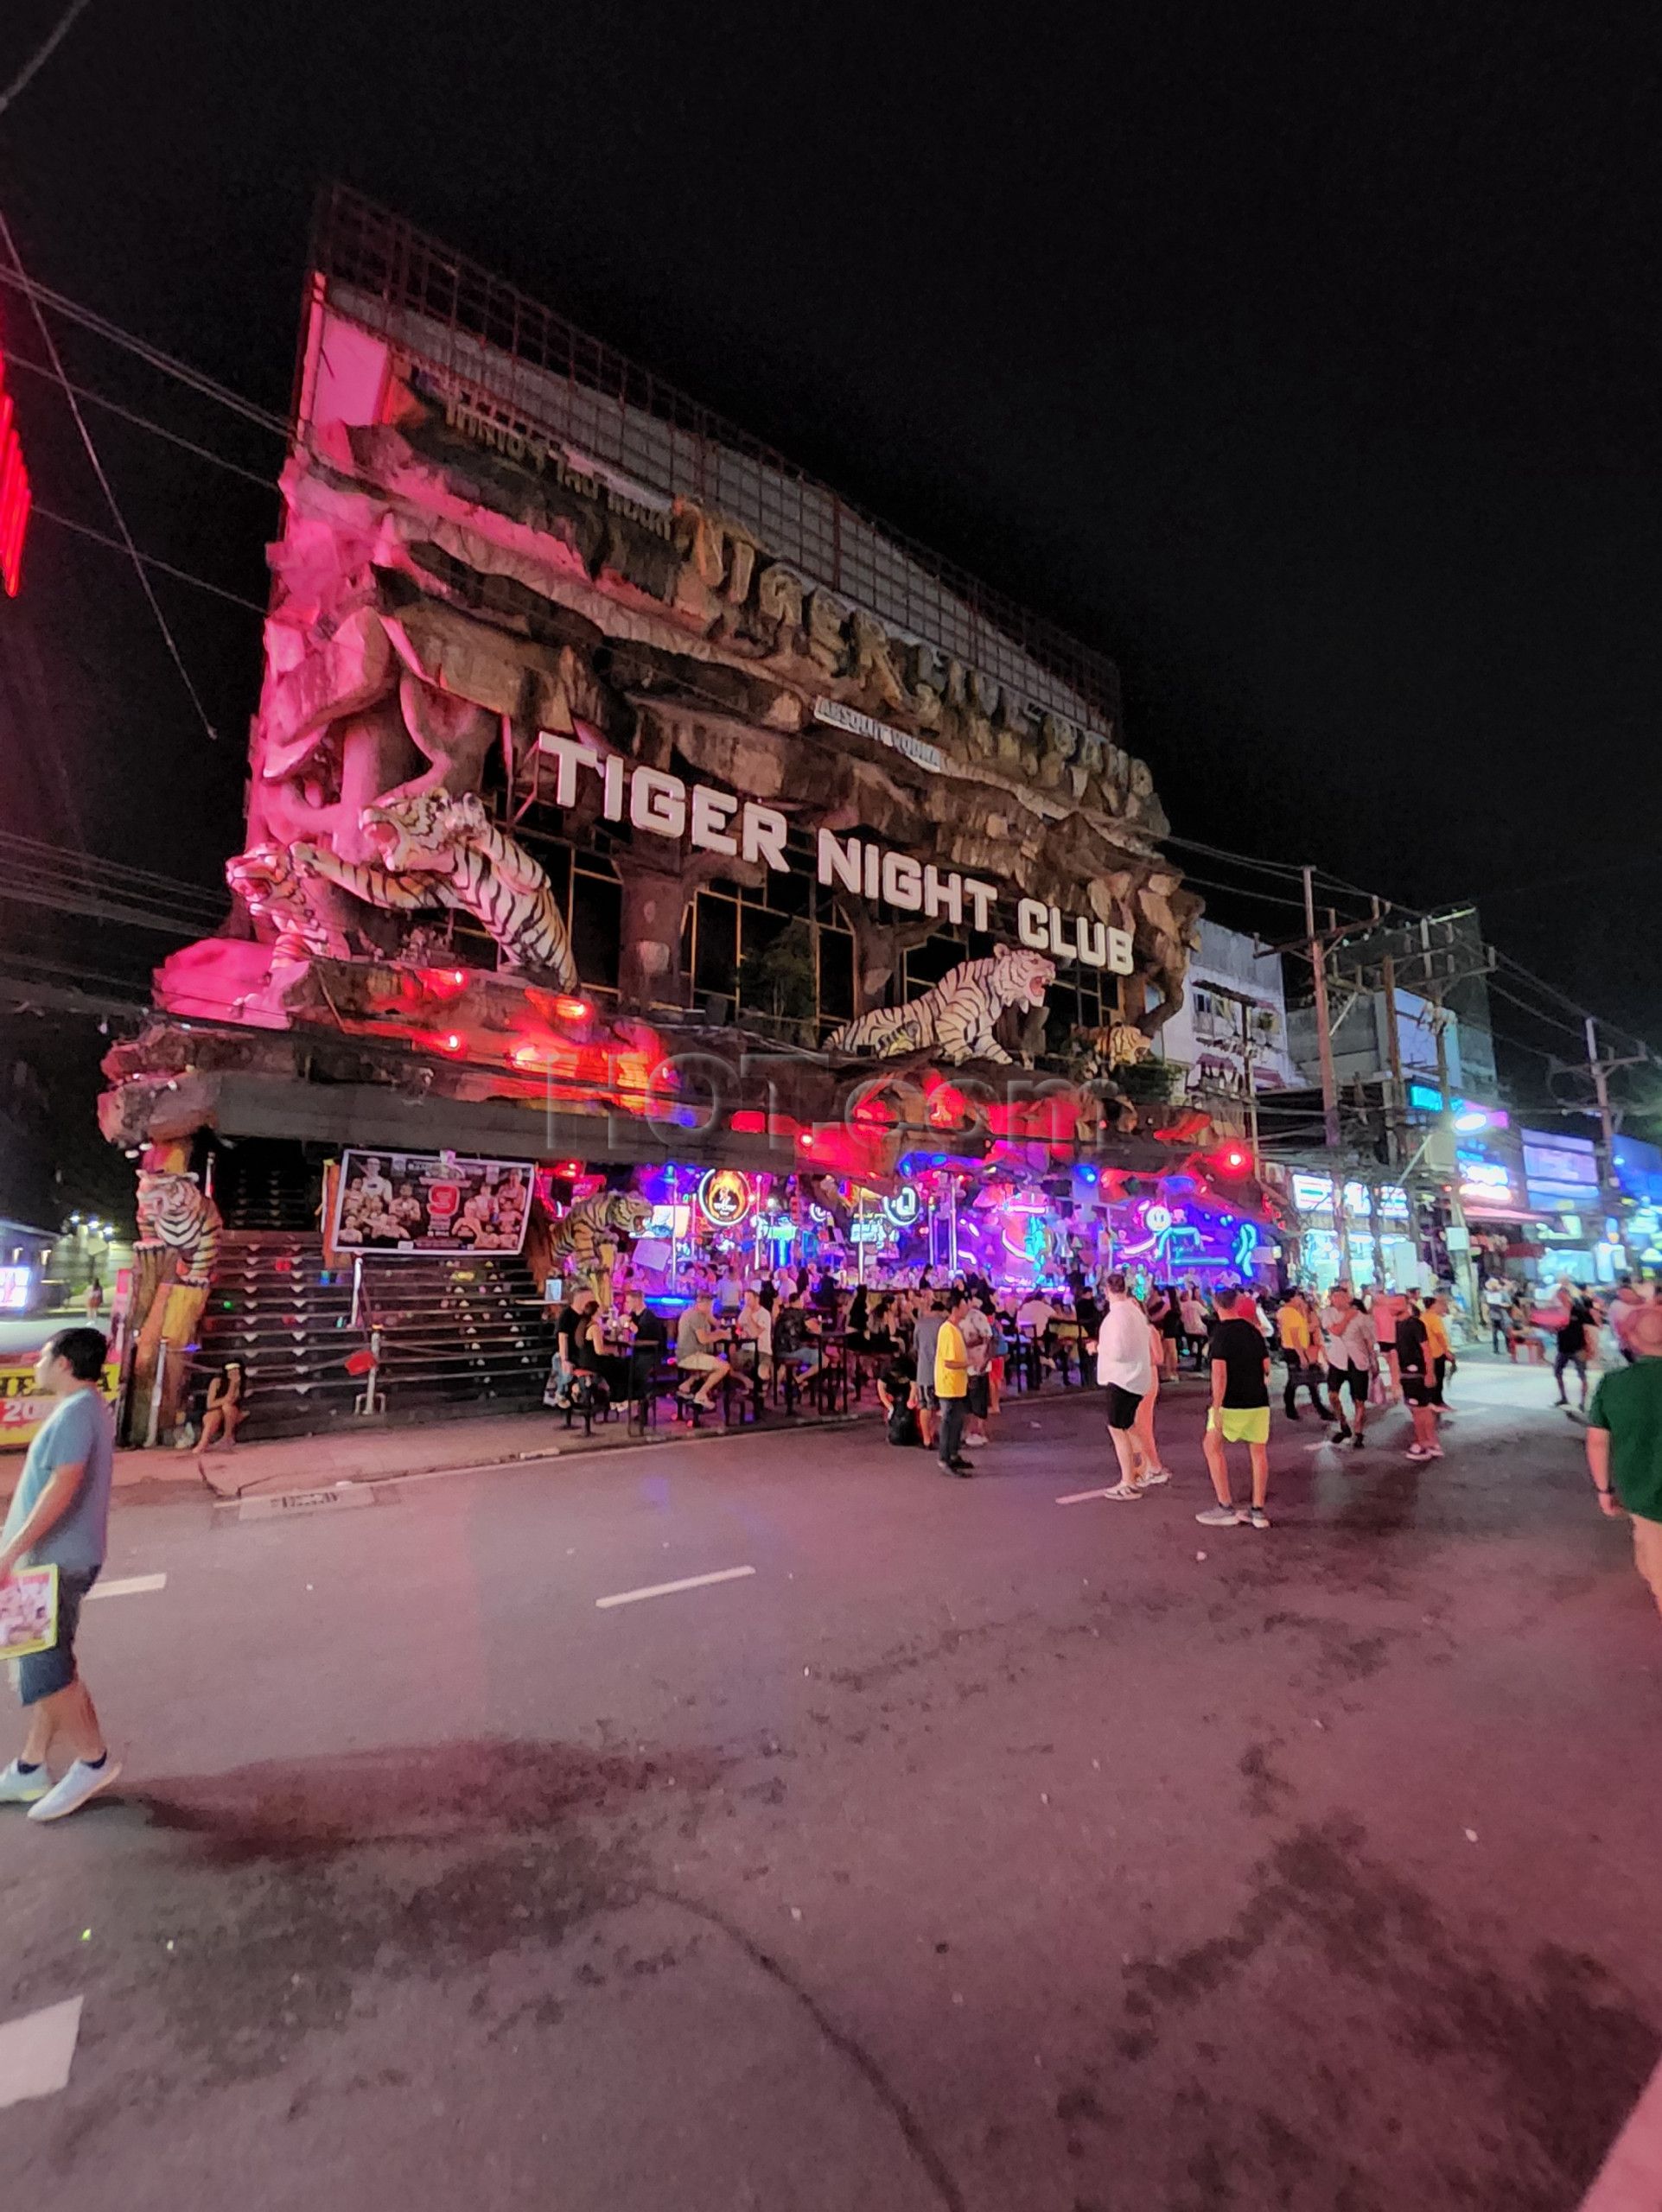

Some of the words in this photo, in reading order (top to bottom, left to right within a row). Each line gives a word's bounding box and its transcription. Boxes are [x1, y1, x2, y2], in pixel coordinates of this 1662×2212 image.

[538, 731, 791, 873] TIGER
[817, 827, 998, 932] NIGHT
[1016, 898, 1135, 976] CLUB
